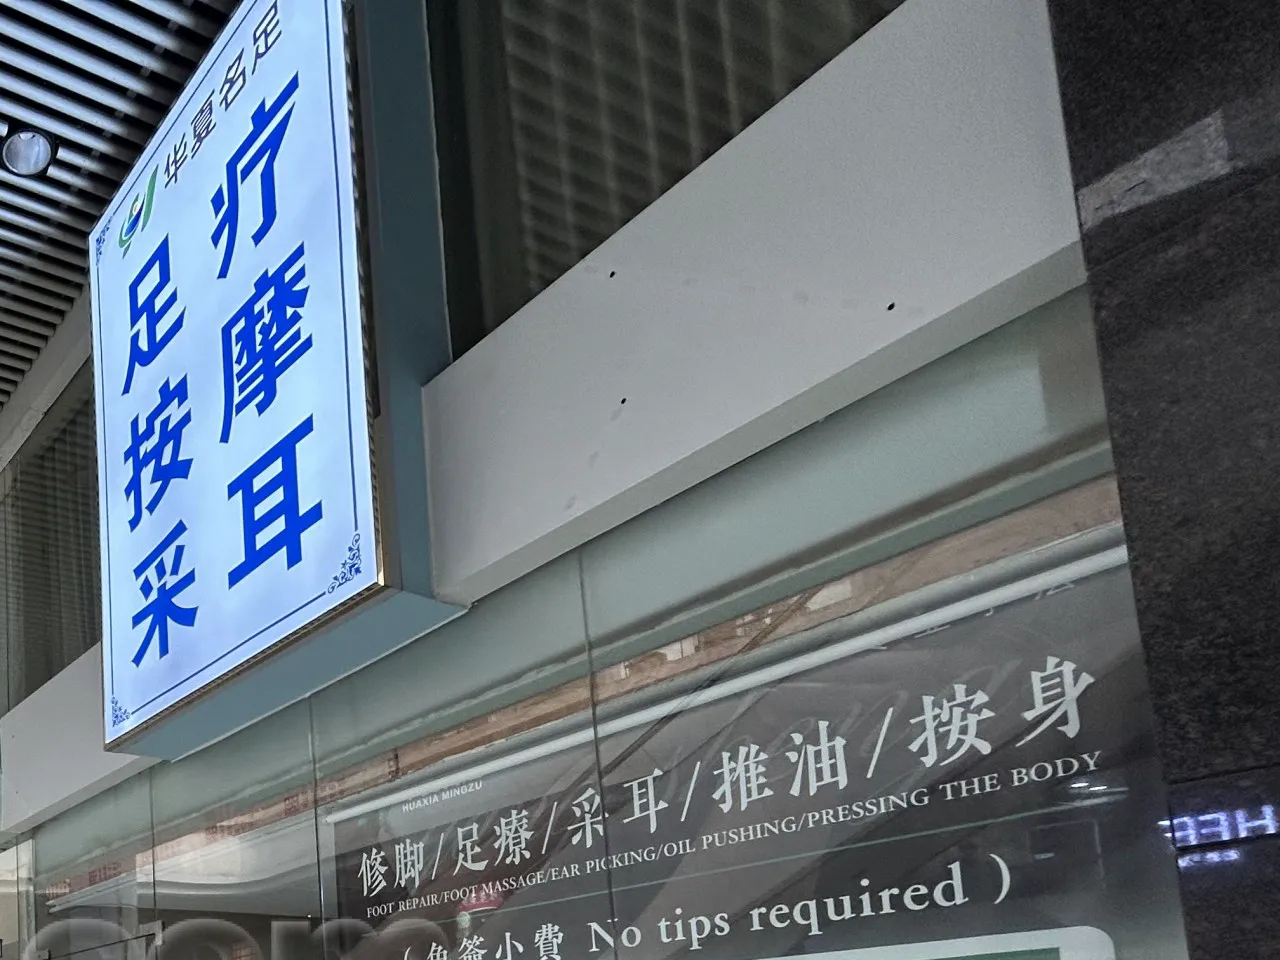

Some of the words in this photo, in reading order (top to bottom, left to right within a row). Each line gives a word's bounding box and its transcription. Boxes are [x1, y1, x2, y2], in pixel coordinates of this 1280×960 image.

[163, 2, 282, 189] 华夏名足
[366, 902, 395, 919] FOOT
[398, 884, 479, 913] REPAIR/FOOT
[481, 862, 581, 894] MASSAGE/EAR
[585, 838, 697, 874] PICKING/OIL
[701, 787, 931, 850] PUSHING/PRESSING
[939, 772, 1002, 801] THE
[1011, 750, 1103, 787] BODY
[402, 794, 439, 813] HUAXIA
[442, 780, 483, 802] MINGZU
[587, 917, 642, 952] No
[657, 907, 731, 950] tips
